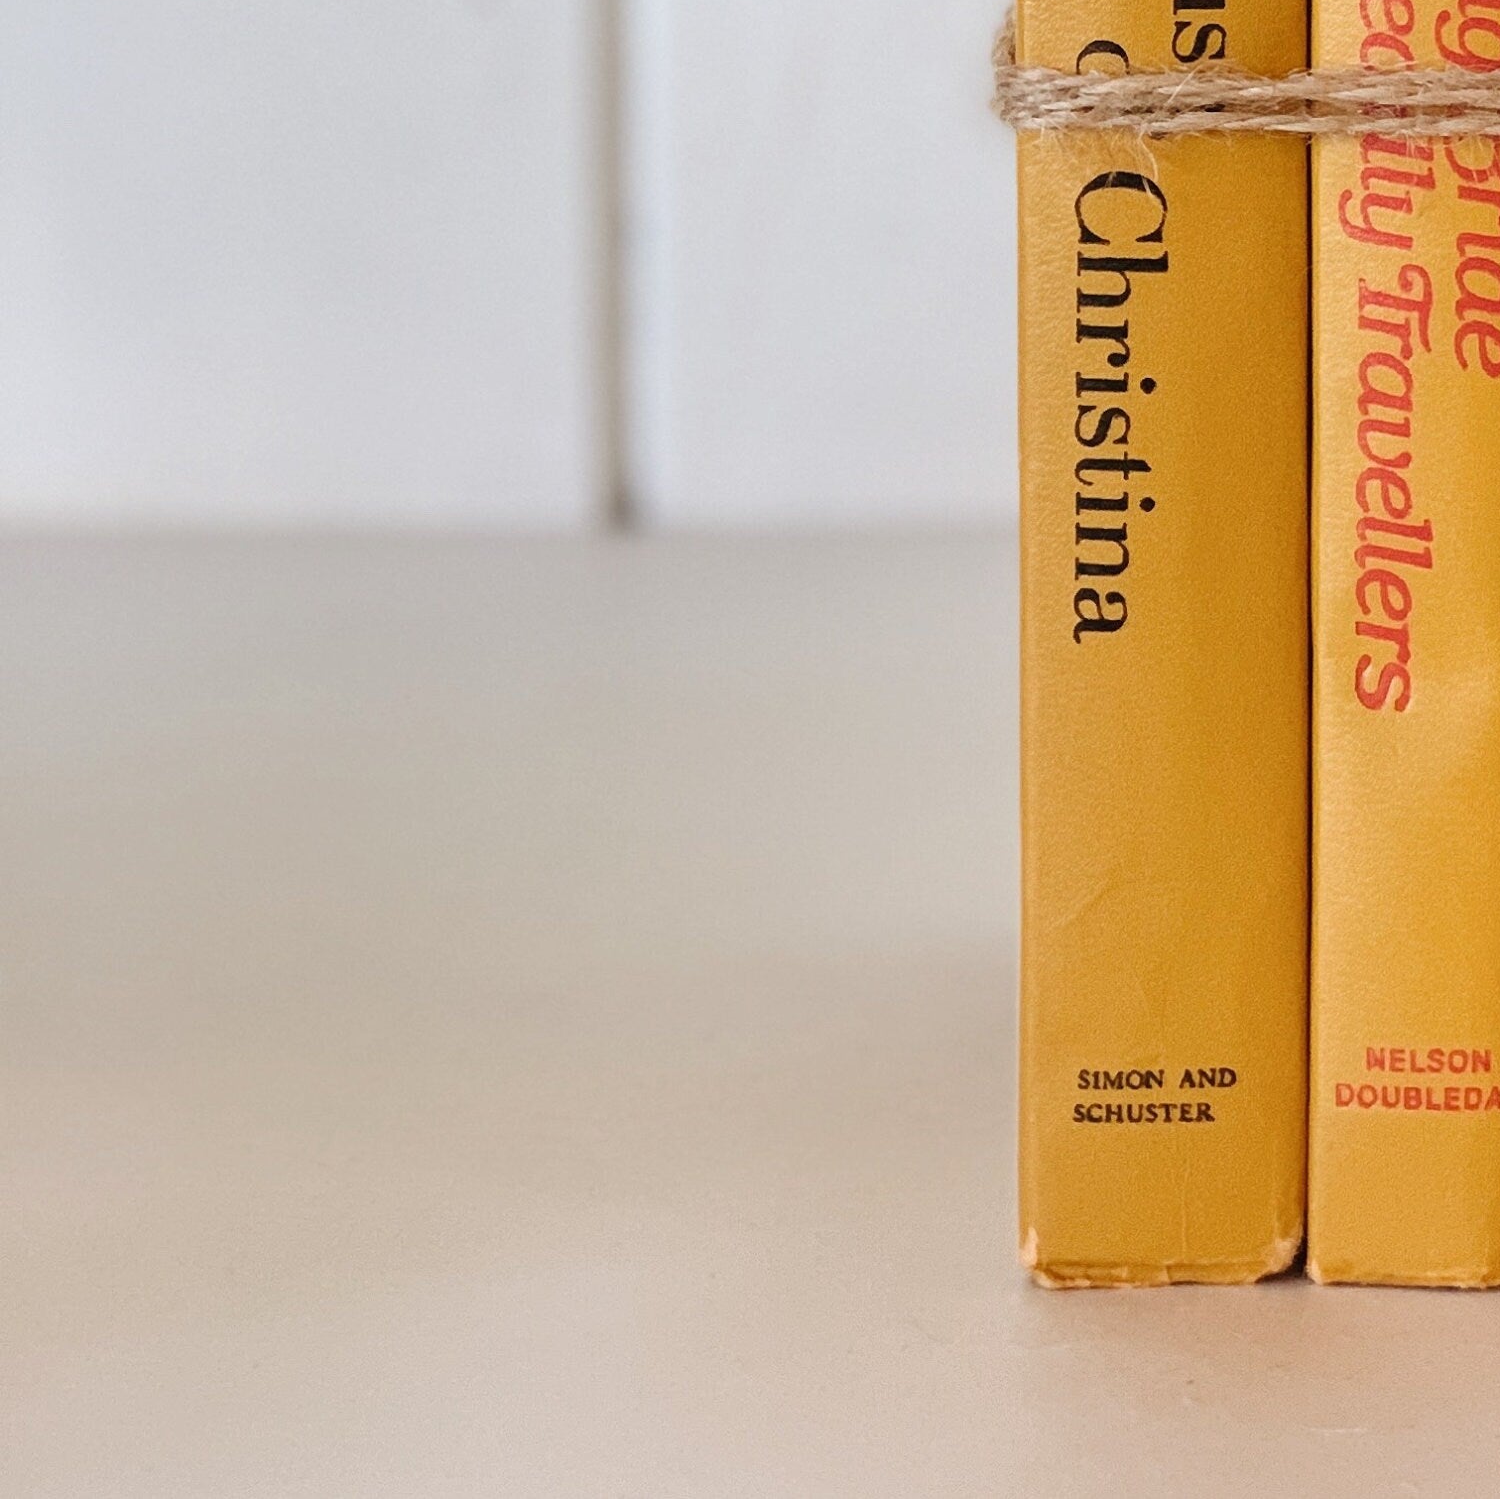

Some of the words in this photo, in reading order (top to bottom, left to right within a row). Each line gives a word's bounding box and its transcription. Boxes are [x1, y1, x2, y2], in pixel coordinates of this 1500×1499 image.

[1072, 170, 1170, 645] Christina
[1354, 263, 1434, 713] Travellers
[1365, 1047, 1492, 1074] NELSON
[1077, 1069, 1165, 1091] SIMON
[1179, 1067, 1237, 1089] AND
[1073, 1102, 1216, 1124] SCHUSTER
